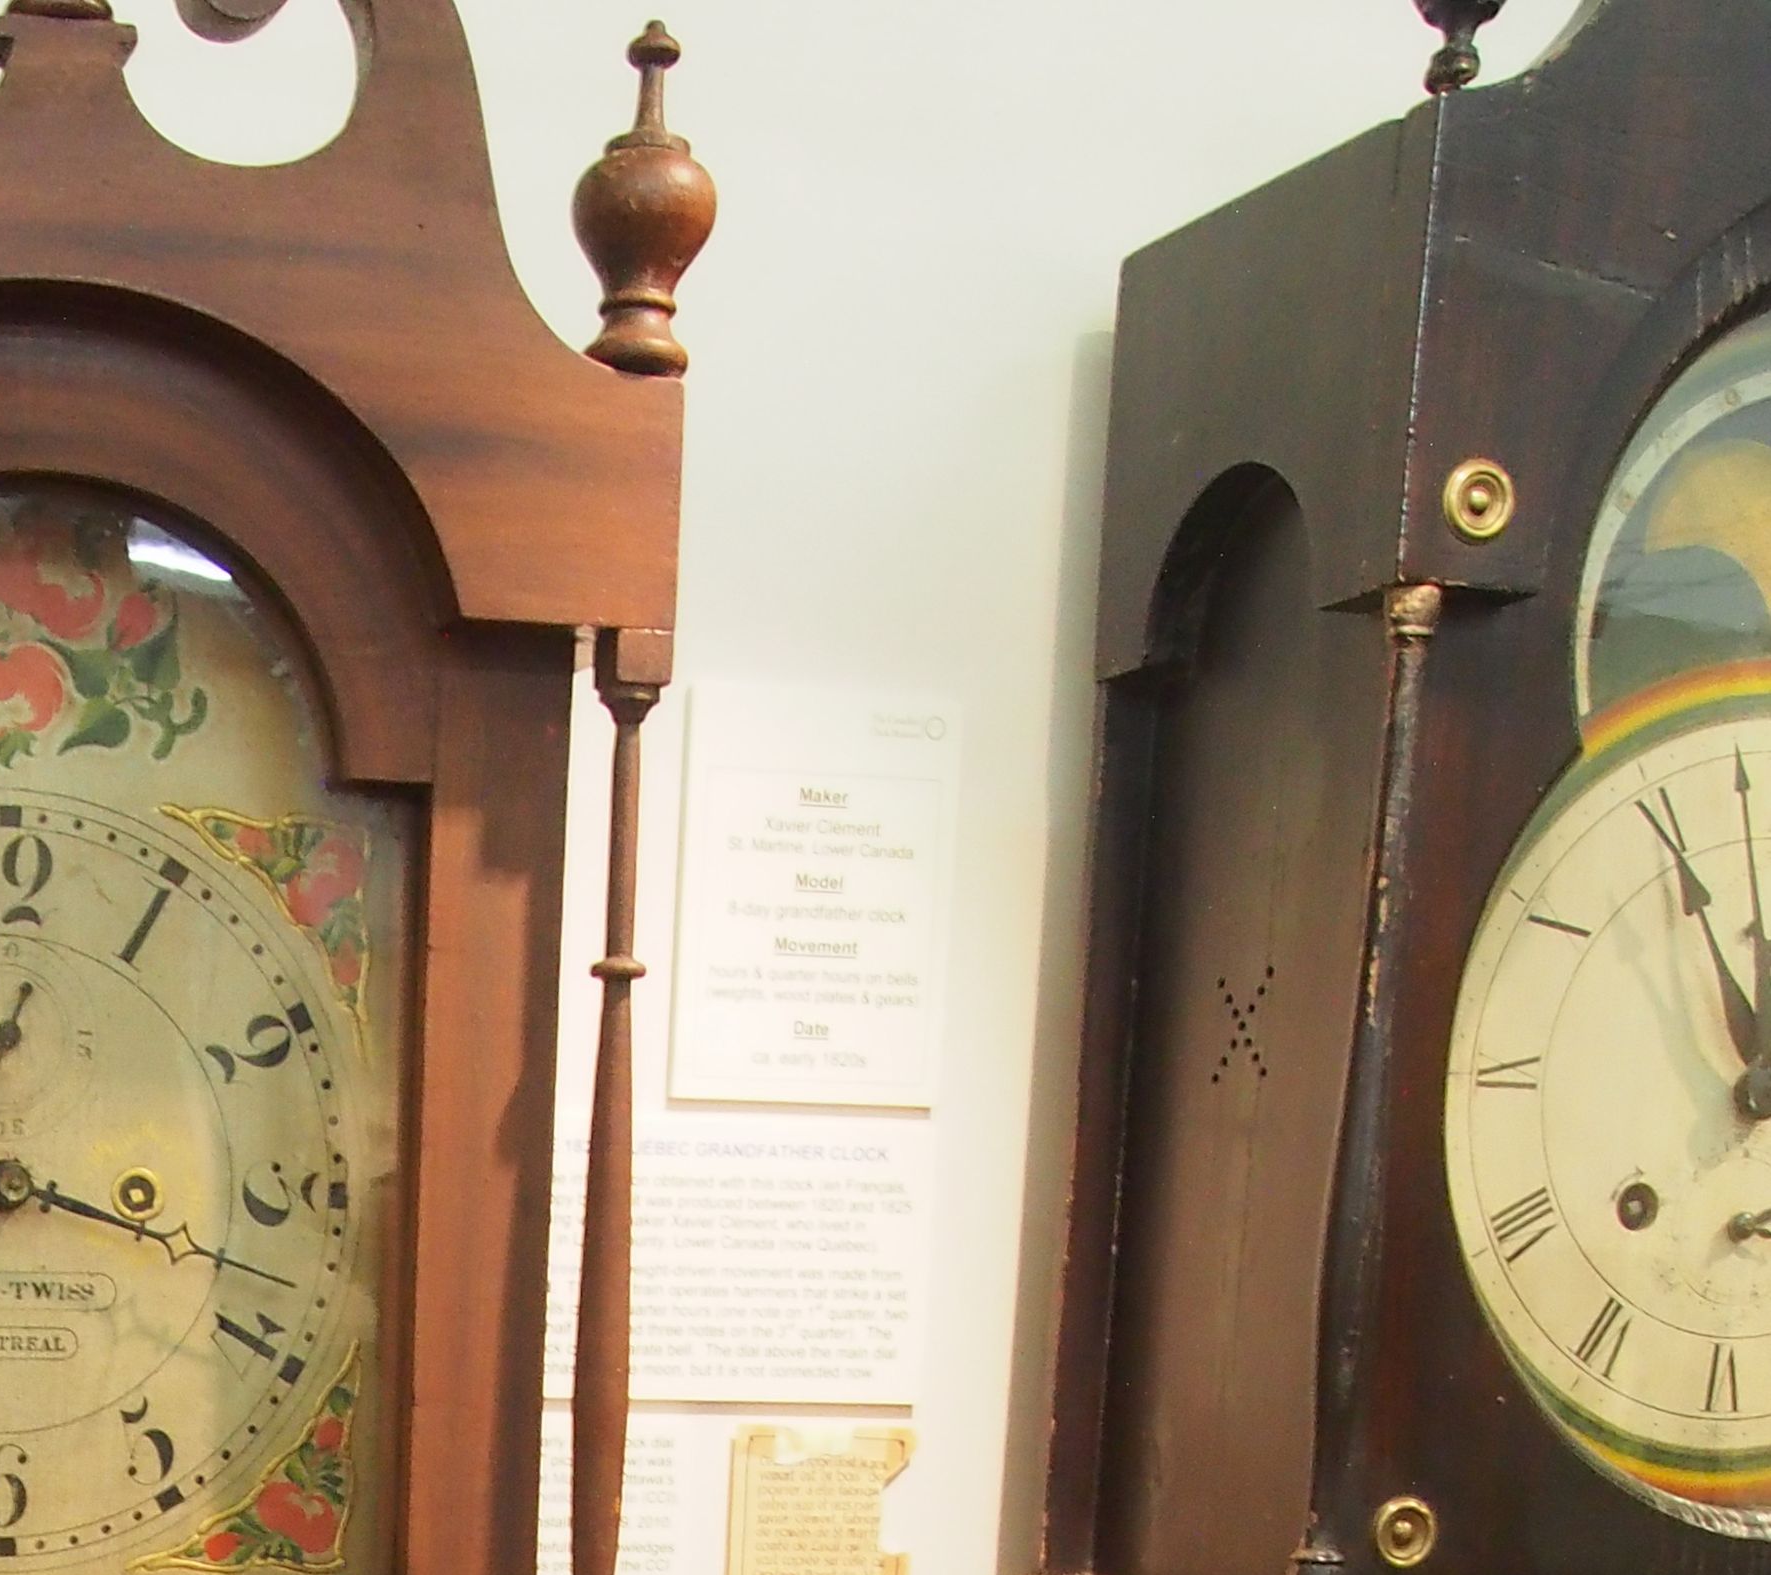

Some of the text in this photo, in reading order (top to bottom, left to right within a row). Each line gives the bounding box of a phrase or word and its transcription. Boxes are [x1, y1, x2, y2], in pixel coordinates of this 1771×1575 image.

[800, 787, 849, 804] Maker
[796, 874, 844, 891] Model
[114, 881, 170, 969] 1
[774, 937, 858, 955] Movement
[206, 1015, 291, 1083] 2
[794, 1022, 829, 1037] Date
[242, 1161, 320, 1227] 3
[211, 1309, 284, 1380] 4
[120, 1397, 174, 1486] 5
